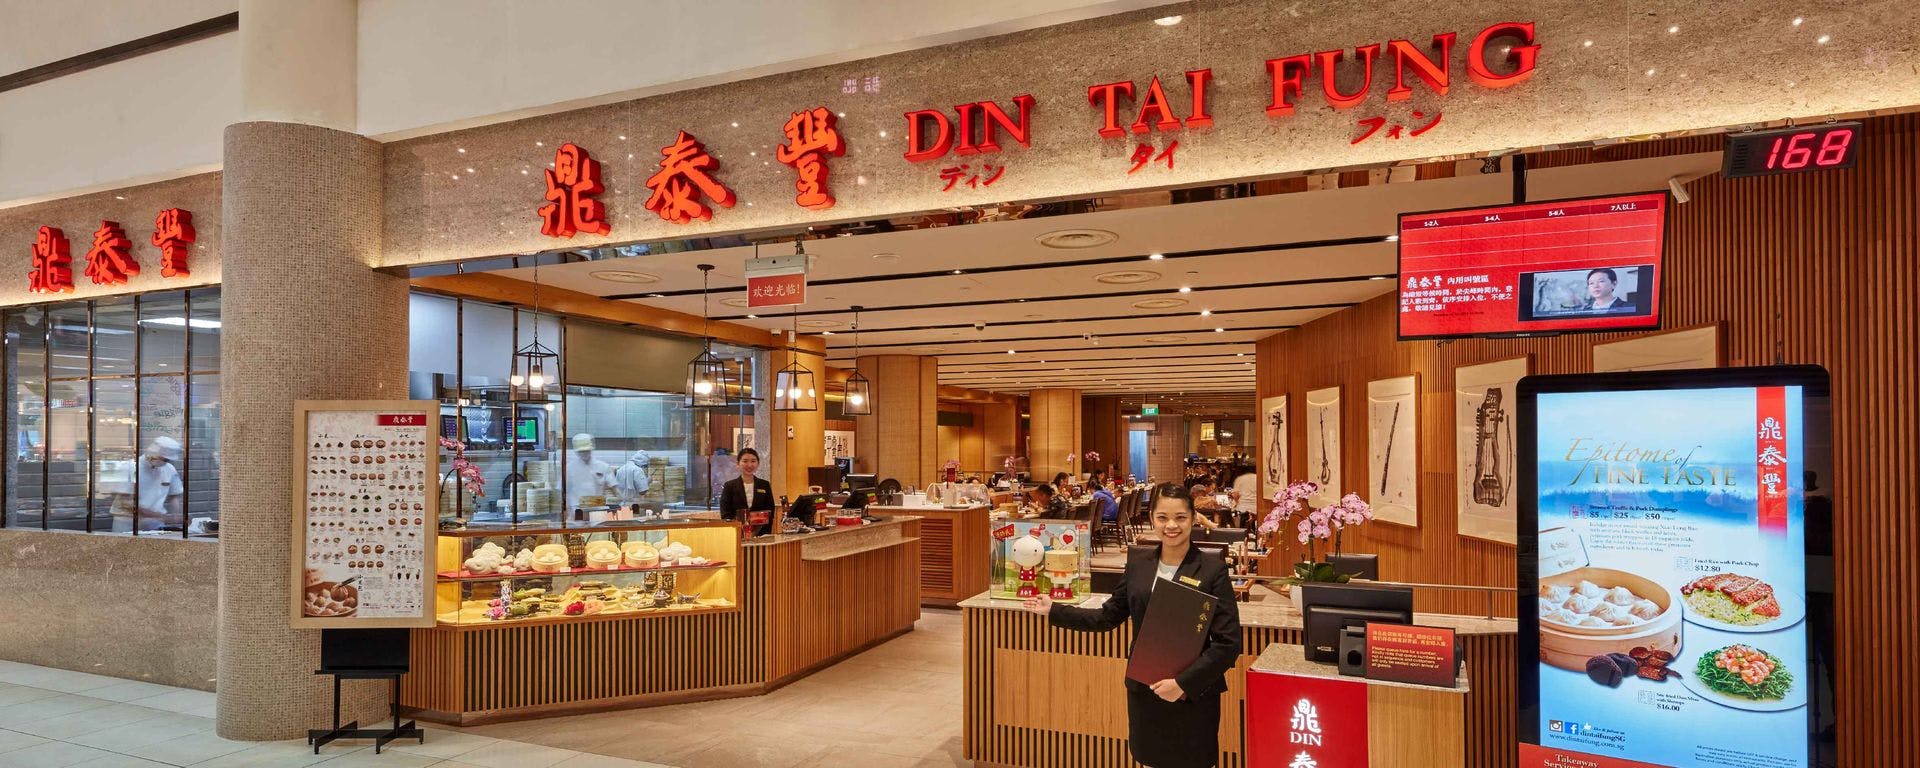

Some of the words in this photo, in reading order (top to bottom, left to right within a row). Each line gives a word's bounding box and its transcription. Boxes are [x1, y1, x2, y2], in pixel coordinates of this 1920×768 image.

[538, 106, 846, 239] 鼎泰豐
[904, 93, 1036, 163] DIN
[1088, 68, 1215, 138] TAI
[1265, 21, 1541, 117] FUNG
[1767, 129, 1853, 169] 168
[940, 163, 1005, 191] ディン
[1128, 139, 1178, 174] タイ
[1350, 112, 1442, 144] フォン
[28, 207, 196, 294] 鼎泰豐
[1564, 436, 1676, 478] Epitome
[1675, 445, 1702, 472] of
[1758, 417, 1787, 494] 鼎泰豐
[1658, 465, 1737, 486] TASTE
[1290, 698, 1322, 734] 鼎
[1657, 703, 1680, 711] $16.00
[1289, 731, 1322, 747] DIN
[1549, 734, 1625, 751] www.dintaifung.com.sg
[1555, 753, 1599, 768] Takeaway
